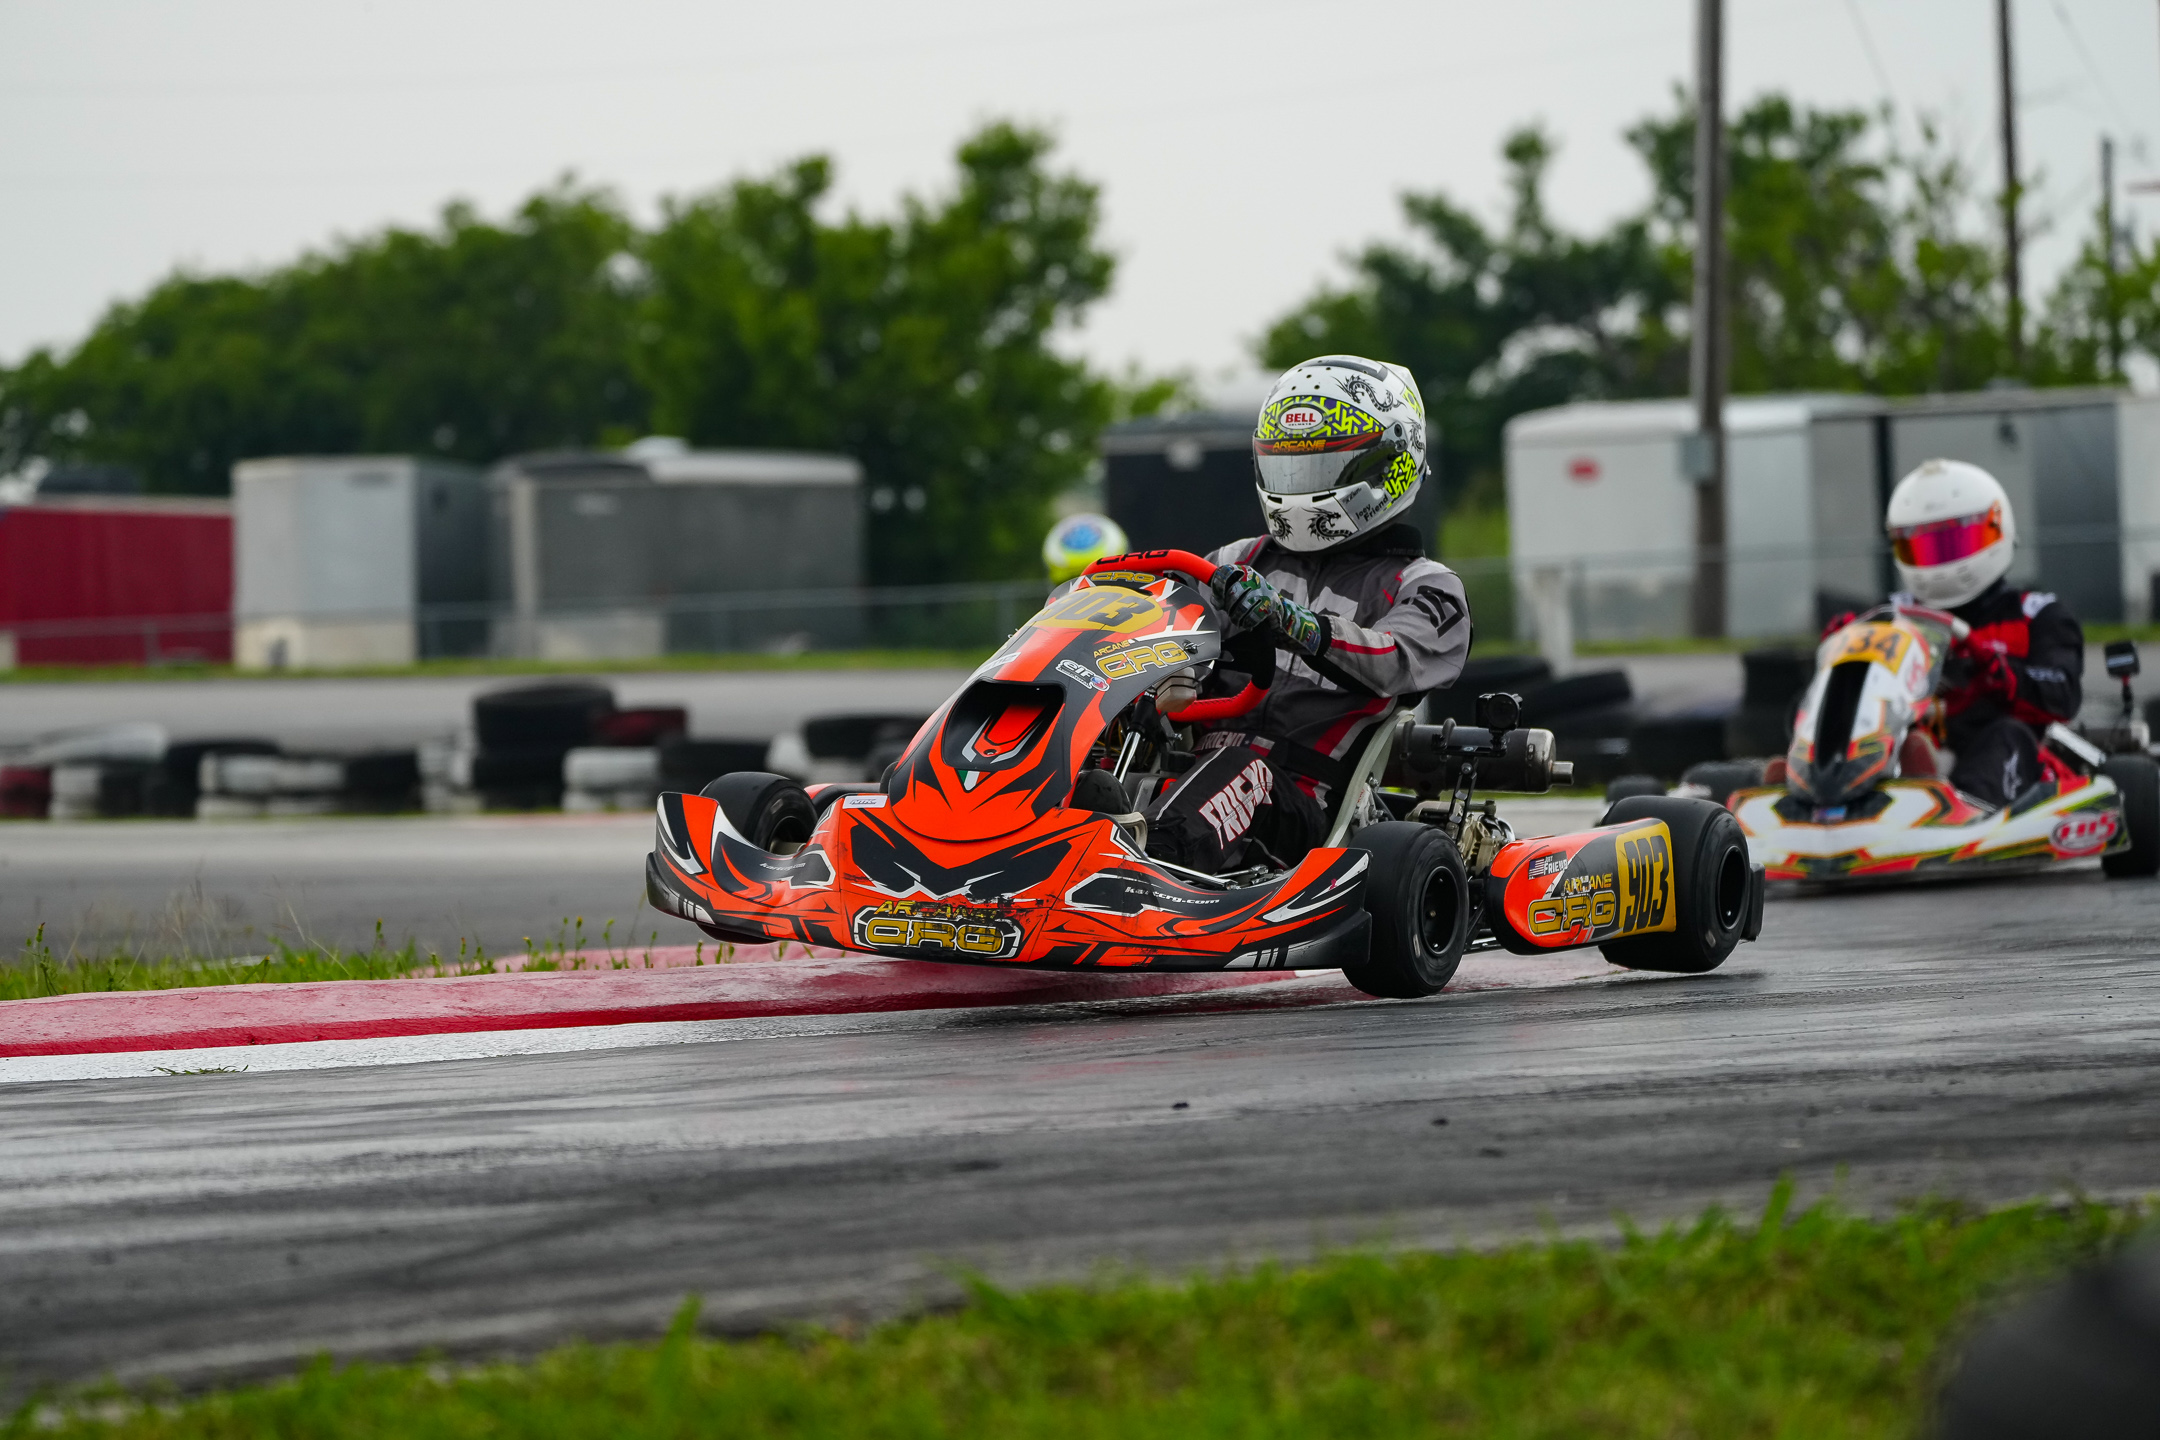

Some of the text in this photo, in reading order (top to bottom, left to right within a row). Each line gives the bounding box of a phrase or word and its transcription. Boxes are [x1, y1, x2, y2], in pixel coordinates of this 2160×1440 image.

[1285, 413, 1316, 423] BELL
[1273, 439, 1327, 450] ARCANE
[1363, 494, 1388, 522] Friend
[1091, 571, 1156, 584] CRG
[1093, 639, 1131, 659] ARCANE
[1096, 640, 1191, 680] CRG
[1623, 835, 1670, 934] 903
[1528, 890, 1617, 937] CRG
[865, 917, 1004, 955] CRG
